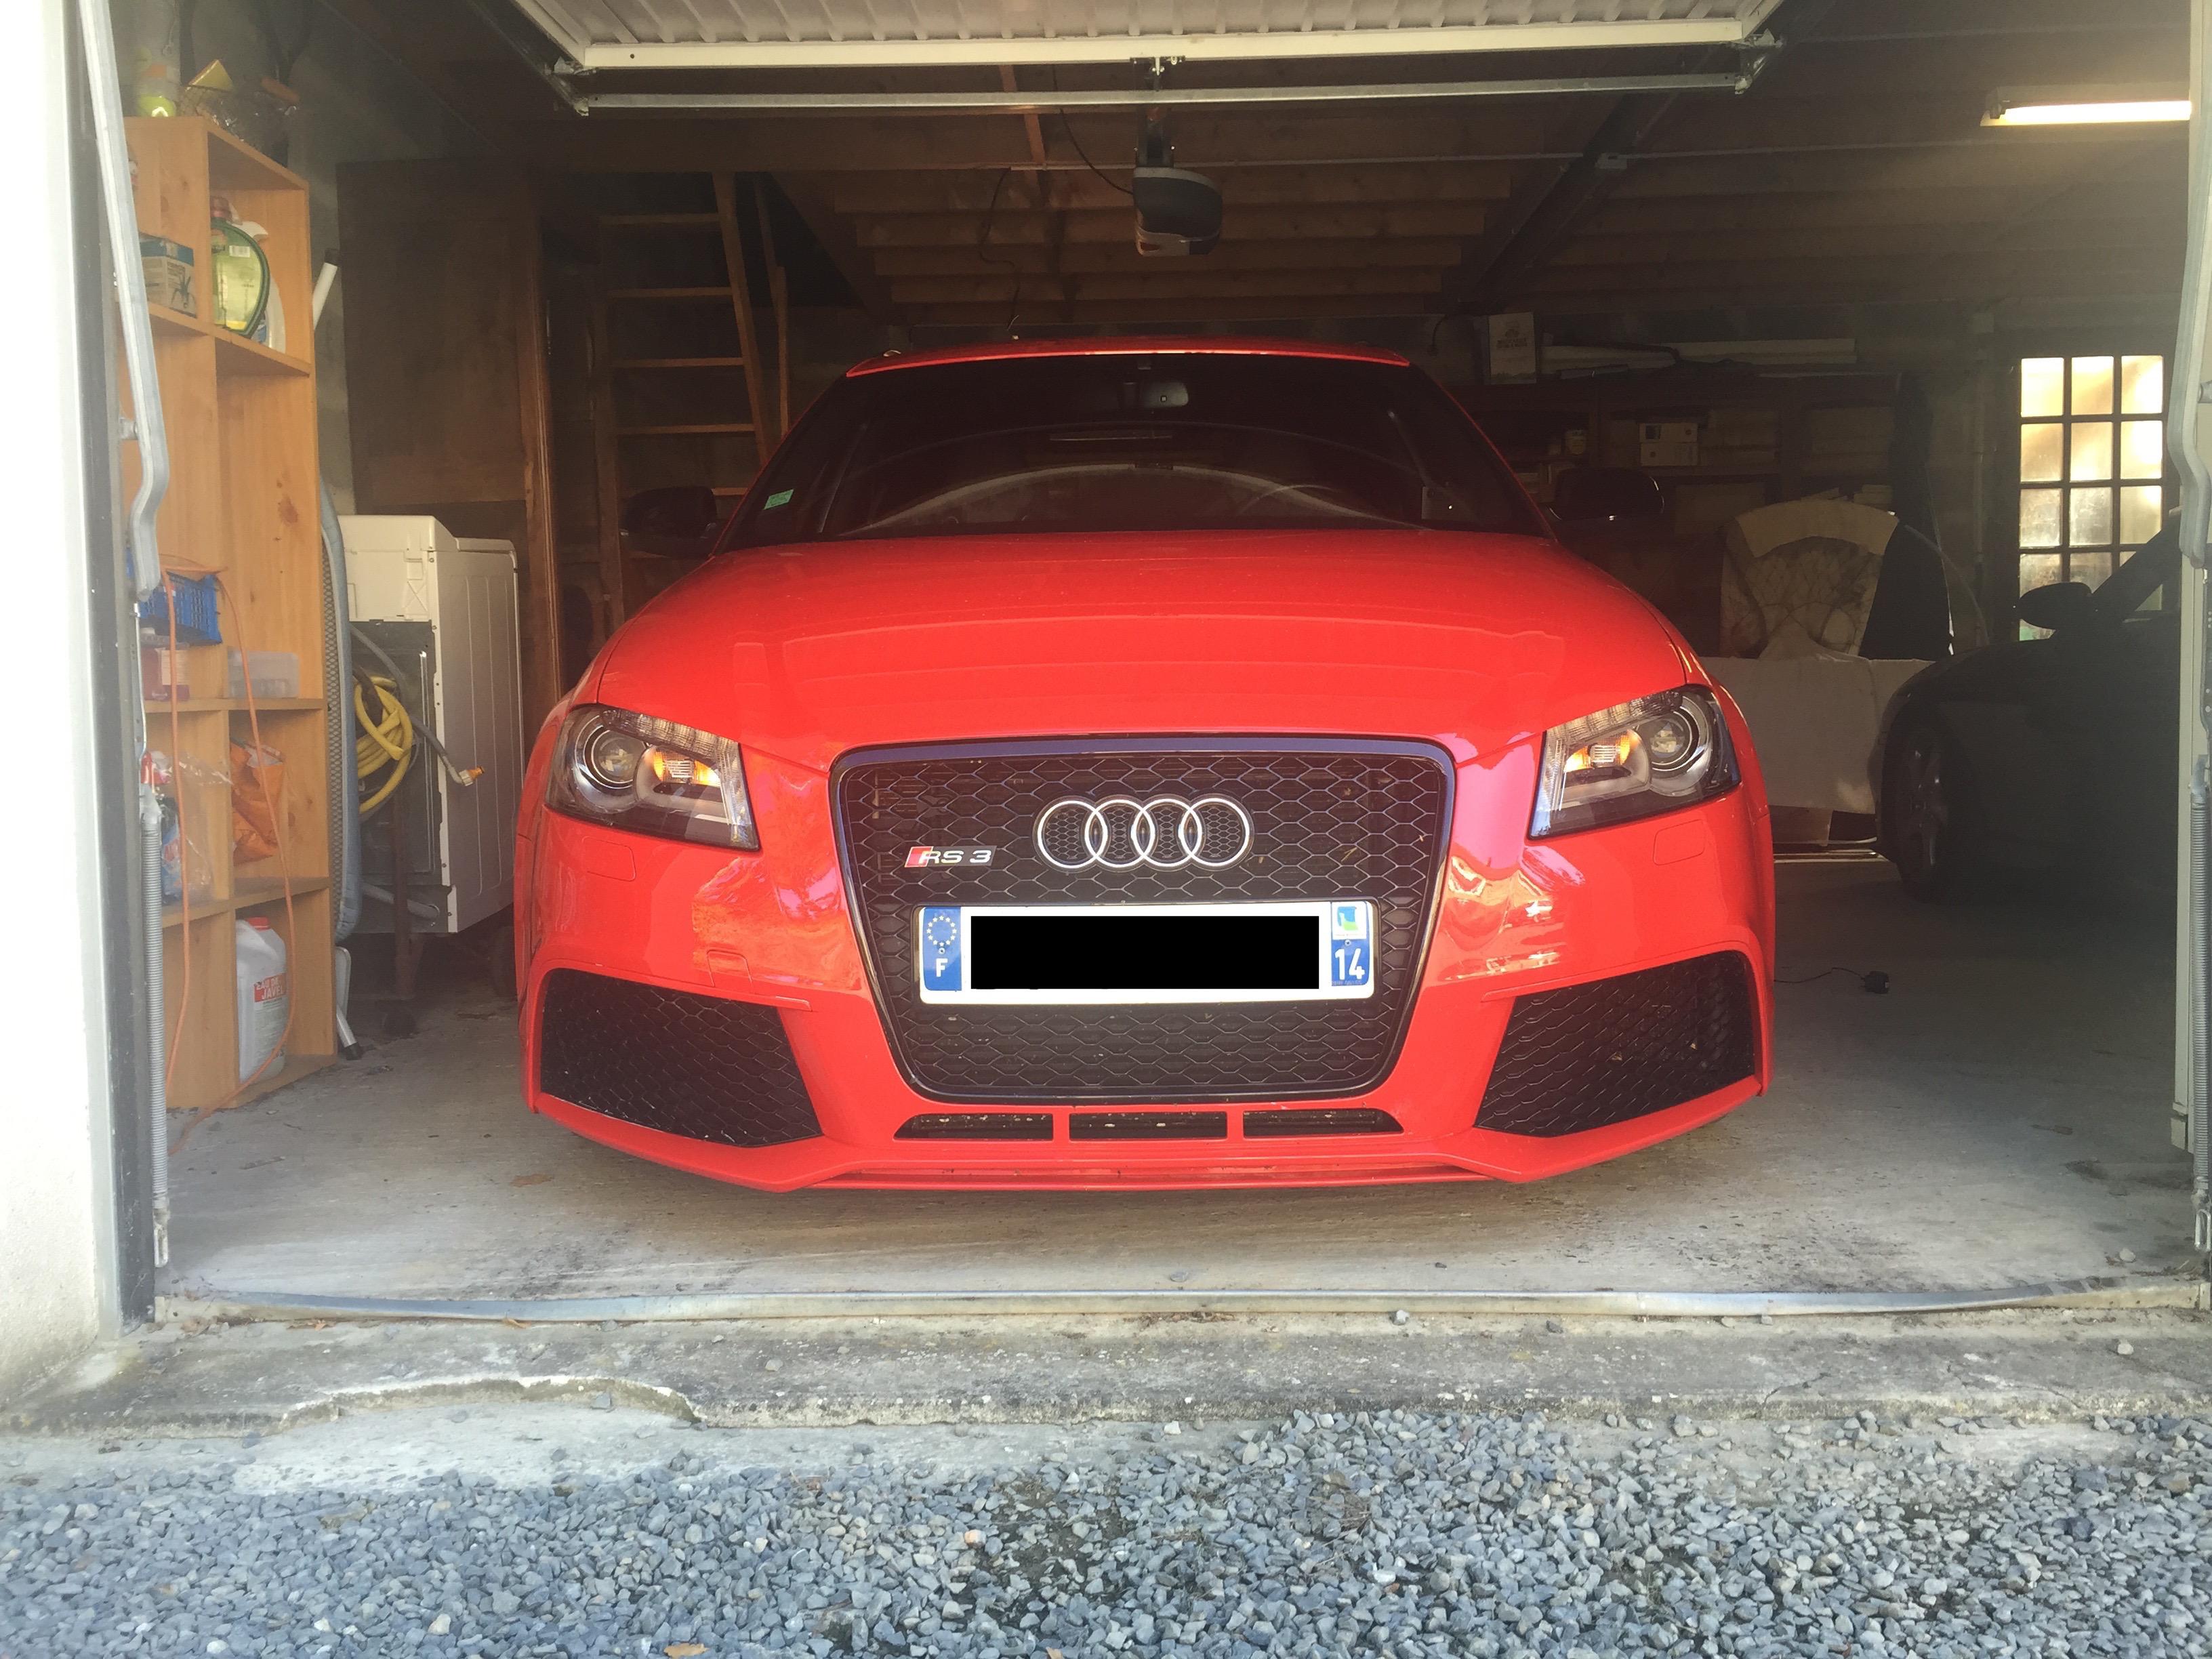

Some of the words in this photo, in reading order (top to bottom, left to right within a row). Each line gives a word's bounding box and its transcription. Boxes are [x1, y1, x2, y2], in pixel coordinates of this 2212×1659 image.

[918, 850, 964, 864] RS
[970, 849, 991, 863] 3
[936, 958, 948, 977] F
[1334, 948, 1366, 980] 14
